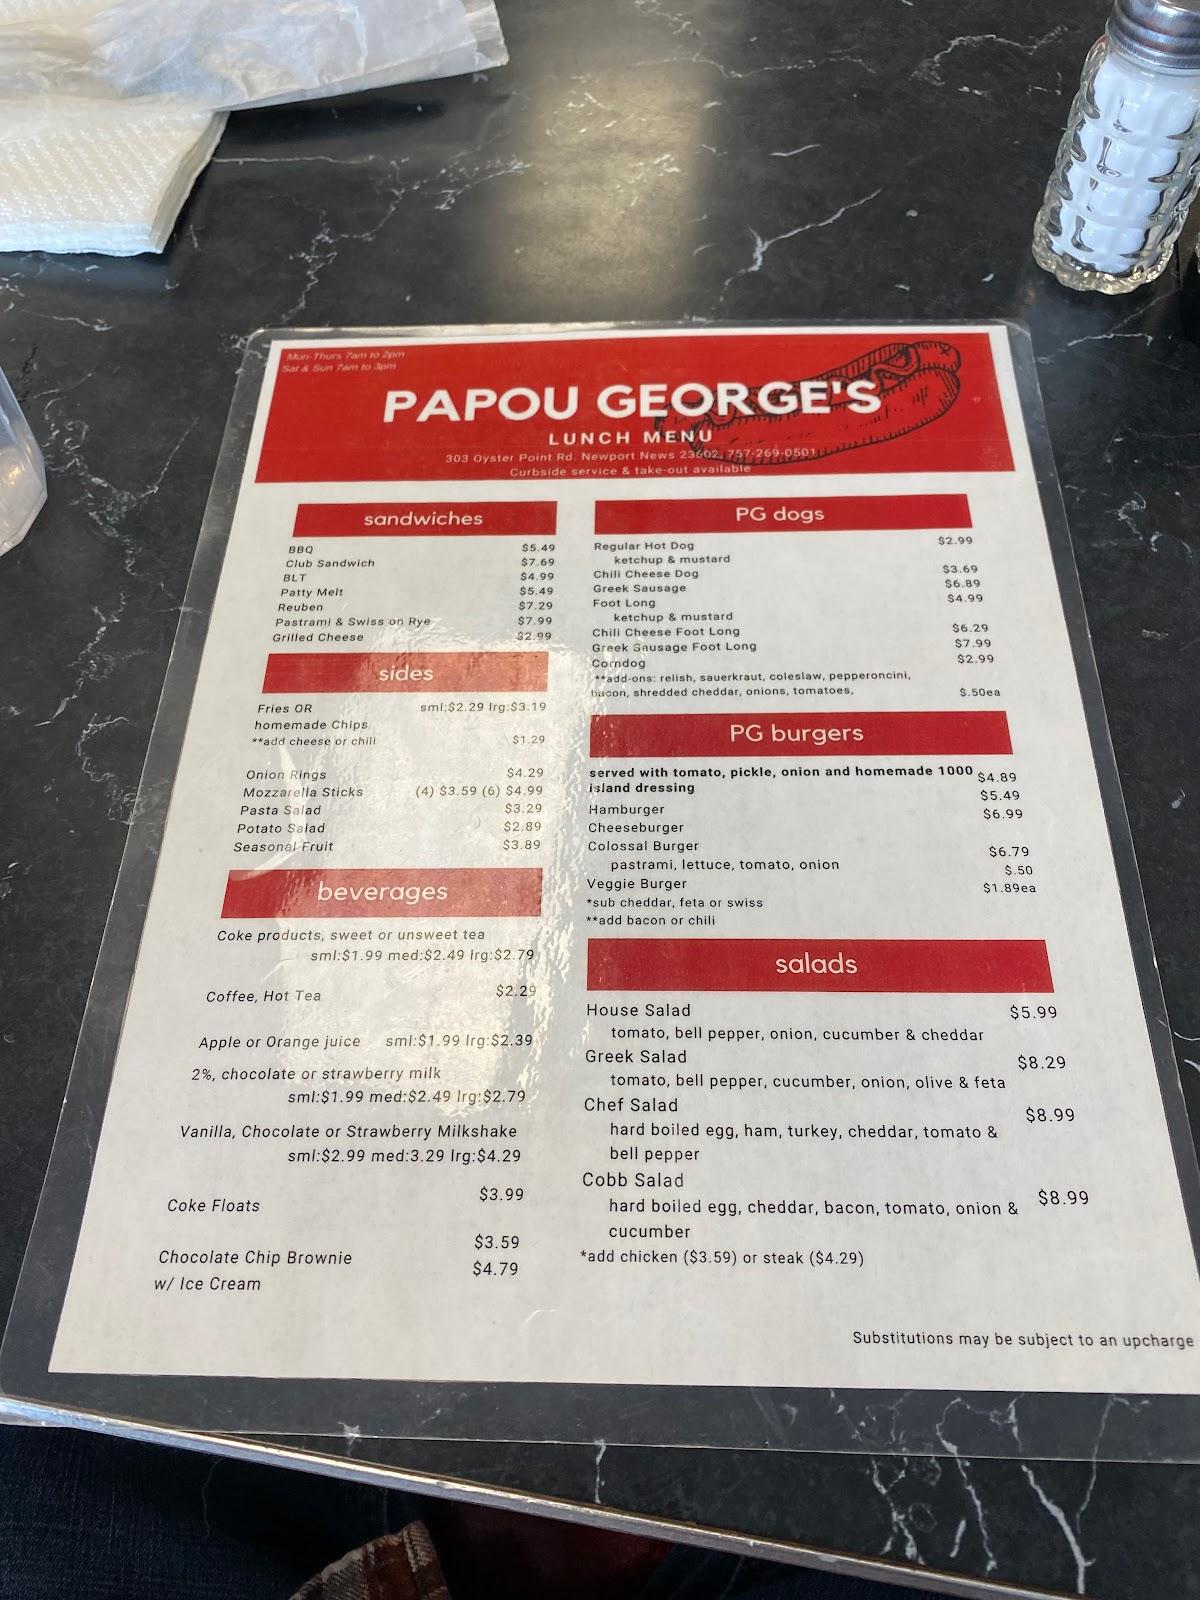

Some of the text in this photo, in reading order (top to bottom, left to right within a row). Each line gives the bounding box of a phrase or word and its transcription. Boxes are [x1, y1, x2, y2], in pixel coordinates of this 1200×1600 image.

[383, 380, 882, 423] PAPOU GEORGE'S
[549, 430, 712, 445] LUNCH MENU
[445, 454, 469, 463] 303
[473, 454, 514, 464] Oyster
[519, 453, 552, 462] Point
[581, 452, 635, 462] Newport
[640, 451, 675, 460] News
[728, 448, 815, 458] 757-269-0501
[510, 467, 566, 476] Curbside
[622, 466, 630, 475] &
[635, 465, 688, 474] take-out
[693, 464, 751, 473] available
[364, 511, 483, 526] sandwiches
[736, 506, 824, 524] PG dogs
[522, 543, 556, 553] $5.49
[594, 541, 694, 552] Regular Hot Dog
[938, 536, 973, 546] $2.99
[288, 546, 314, 554] BBQ
[286, 559, 375, 568] Club Sandwich
[521, 557, 555, 567] $7.69
[283, 574, 307, 582] BLT
[520, 572, 554, 581] $4.99
[280, 587, 343, 598] Patty Melt
[519, 586, 554, 596] $5.49
[947, 593, 983, 603] $4.99
[278, 603, 323, 612] Reuben
[593, 599, 656, 609] Foot Long
[518, 616, 552, 626] $7.99
[592, 627, 740, 638] Chili Cheese Foot Long
[952, 623, 988, 634] $6.29
[955, 638, 991, 648] $7.99
[957, 653, 994, 664] $2.99
[379, 664, 434, 681] sides
[660, 674, 696, 683] relish,
[700, 672, 765, 682] sauerkraut,
[769, 672, 825, 681] coleslaw,
[829, 671, 911, 682] pepperoncini,
[960, 687, 1001, 697] $.50ea
[257, 704, 312, 714] Fries OR
[254, 720, 368, 732] homemade Chips
[730, 724, 864, 746] PG burgers
[506, 767, 544, 779] $4.29
[590, 765, 973, 779] served with tomato, pickle, onion and homemade 1000
[978, 772, 1016, 783] $4.89
[589, 782, 694, 795] island dressing
[980, 789, 1020, 801] $5.49
[589, 804, 665, 817] Hamburger
[983, 808, 1023, 820] $6.99
[588, 822, 684, 835] Cheeseburger
[588, 840, 699, 854] Colossal Burger
[989, 846, 1029, 858] $6.79
[587, 878, 687, 892] Veggie Burger
[318, 880, 448, 905] beverages
[776, 952, 858, 974] salads
[206, 990, 321, 1004] Coffee, Hot Tea
[587, 1003, 690, 1017] House Salad
[1010, 1004, 1057, 1020] $5.99
[198, 1035, 360, 1051] Apple or Orange juice
[586, 1049, 686, 1064] Greek Salad
[1018, 1054, 1066, 1071] $8.29
[191, 1066, 440, 1082] 2%, chocolate or strawberry milk
[610, 1073, 1006, 1090] tomato, bell pepper, cucumber, onion, olive & feta
[584, 1097, 678, 1112] Chef Salad
[1026, 1106, 1074, 1124] $8.99
[181, 1124, 517, 1141] Vanilla, Chocolate or Strawberry Milkshake
[288, 1148, 521, 1166] sml:$2.99 med:3.29 lrg:$4.29
[582, 1172, 684, 1188] Cobb Salad
[479, 1186, 524, 1202] $3.99
[1038, 1188, 1088, 1206] $8.99
[168, 1198, 260, 1212] Coke Floats
[474, 1233, 520, 1250] $3.59
[159, 1250, 352, 1267] Chocolate Chip Brownie
[620, 1250, 677, 1263] chicken
[684, 1249, 737, 1266] ($3.59)
[743, 1254, 758, 1264] or
[763, 1251, 804, 1264] steak
[810, 1250, 864, 1268] ($4.29)
[473, 1260, 518, 1277] $4.79
[154, 1276, 261, 1291] w/ Ice Cream
[853, 1330, 1194, 1350] Substitutions may be subject to an upcharge
